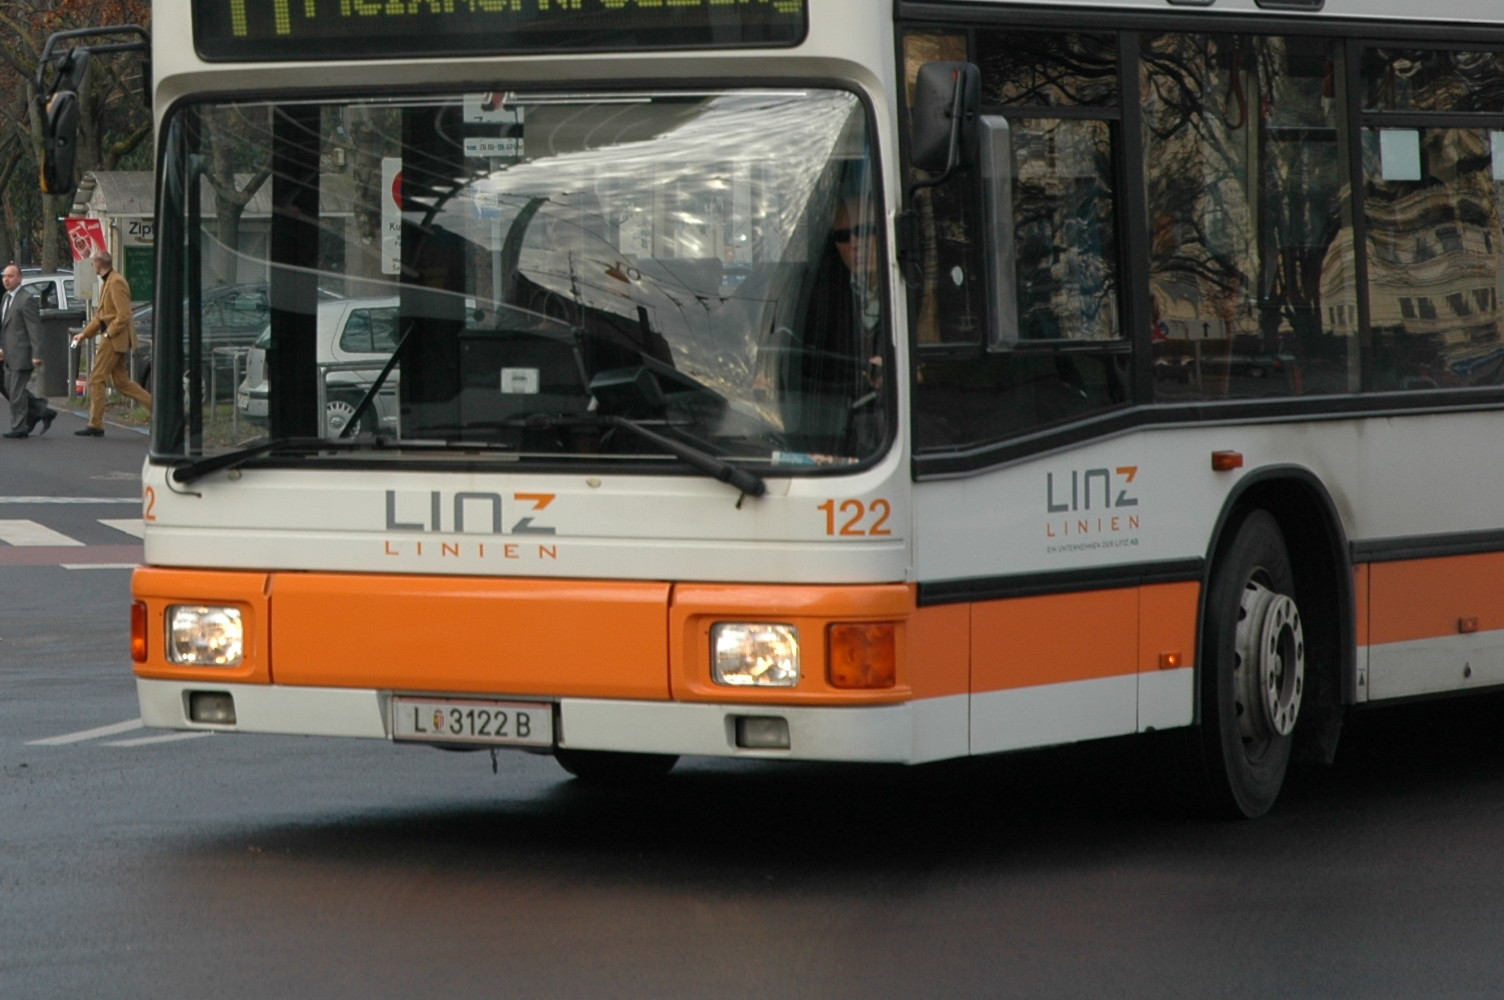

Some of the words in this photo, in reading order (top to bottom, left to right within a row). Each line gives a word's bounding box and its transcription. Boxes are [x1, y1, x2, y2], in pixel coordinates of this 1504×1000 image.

[129, 221, 153, 237] Zip
[1047, 465, 1139, 514] LINZ
[385, 489, 557, 535] LINZ
[817, 498, 892, 536] 122
[1047, 515, 1140, 538] LINIEN
[385, 540, 558, 560] LINIEN
[414, 707, 427, 733] L
[449, 708, 508, 737] 3122
[516, 712, 531, 737] B
